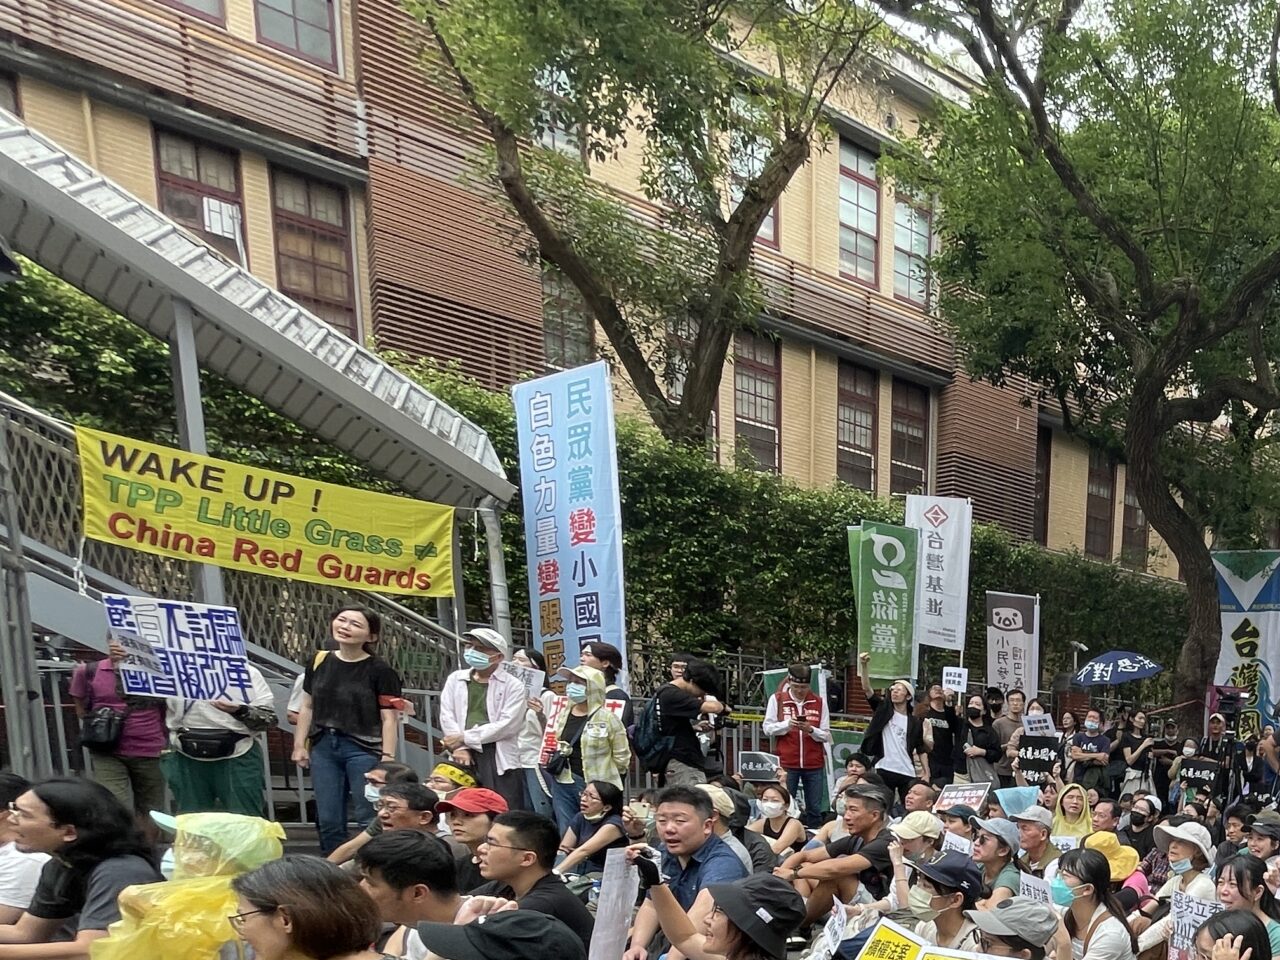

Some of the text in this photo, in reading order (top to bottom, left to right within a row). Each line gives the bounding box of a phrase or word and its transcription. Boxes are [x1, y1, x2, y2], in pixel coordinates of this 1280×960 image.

[101, 439, 226, 494] WAKE
[244, 474, 296, 505] UP
[102, 473, 183, 514] TPP
[196, 496, 291, 539] Little
[304, 518, 404, 558] Grass
[107, 512, 432, 590] China Red Guards
